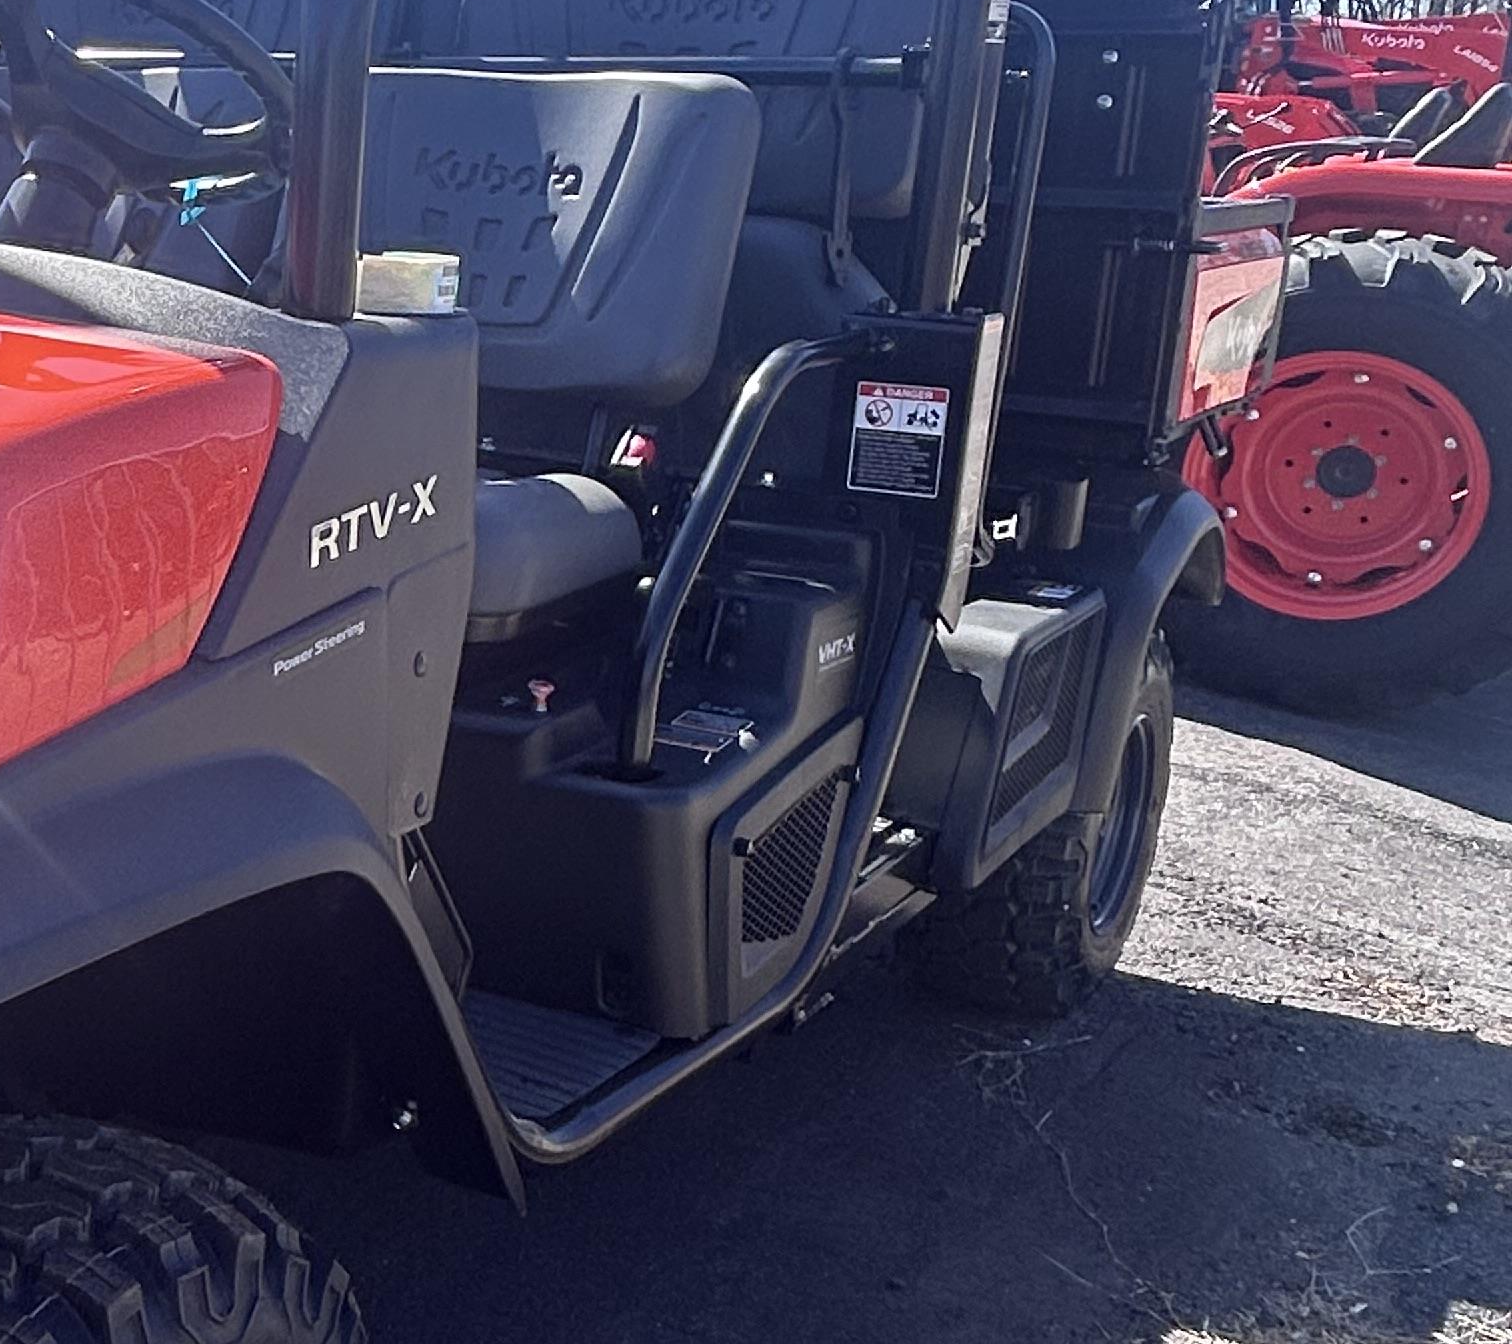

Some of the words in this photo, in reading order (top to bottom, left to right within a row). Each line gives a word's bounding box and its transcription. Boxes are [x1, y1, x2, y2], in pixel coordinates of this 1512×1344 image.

[1360, 31, 1426, 50] Kubota
[414, 146, 584, 197] Kubota
[886, 387, 934, 400] DANGER
[309, 474, 439, 569] RTV-X
[273, 646, 315, 676] Power
[314, 620, 366, 656] Steering
[818, 632, 856, 664] VHT-X
